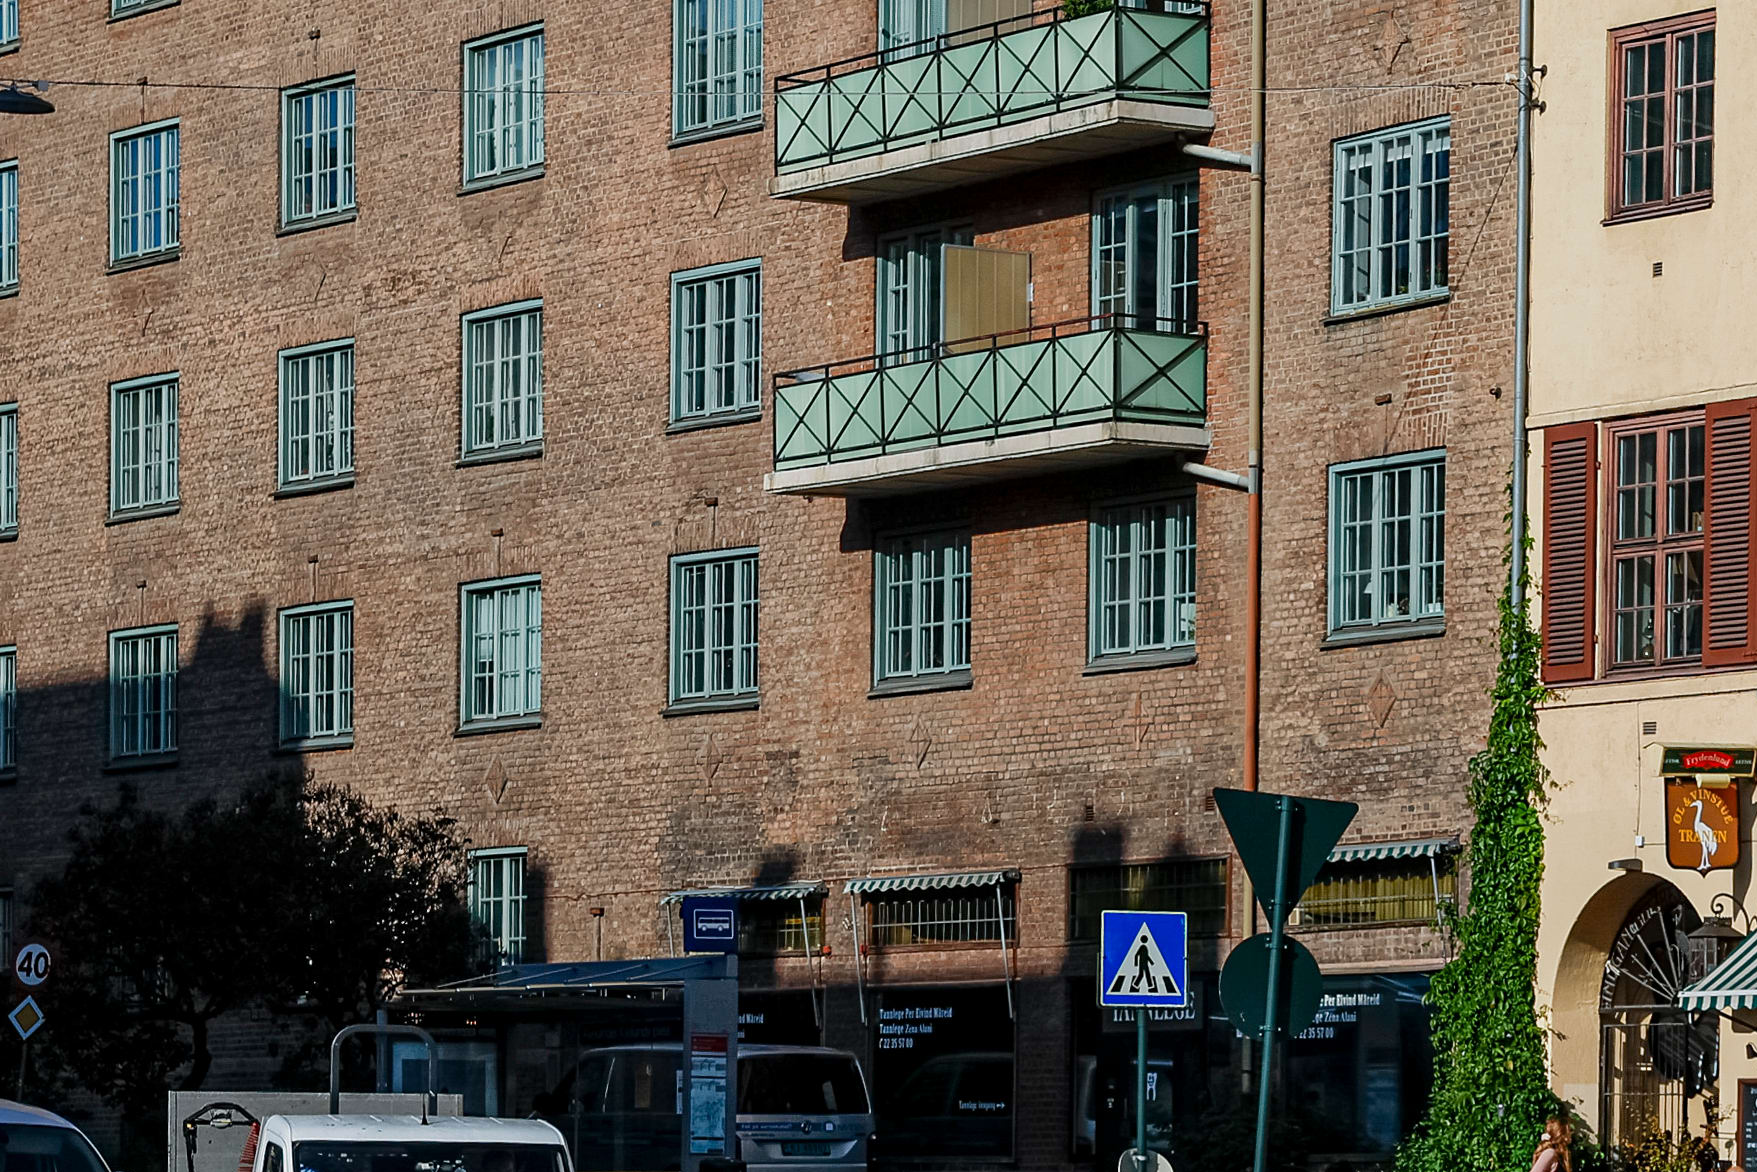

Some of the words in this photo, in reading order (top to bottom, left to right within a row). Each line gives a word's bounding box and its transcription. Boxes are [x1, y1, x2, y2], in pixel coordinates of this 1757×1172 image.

[1685, 753, 1732, 767] Frydenlund
[1673, 805, 1686, 825] ØL
[1683, 796, 1693, 807] &
[1690, 789, 1734, 825] VINSTUE
[18, 951, 49, 979] 40
[1323, 994, 1336, 1006] Per
[1336, 993, 1357, 1006] Eivind
[879, 1008, 904, 1020] Tannlege
[905, 1008, 915, 1019] Per
[879, 1023, 904, 1035] Tannlege
[1308, 1027, 1316, 1039] 35
[1316, 1027, 1325, 1039] 57
